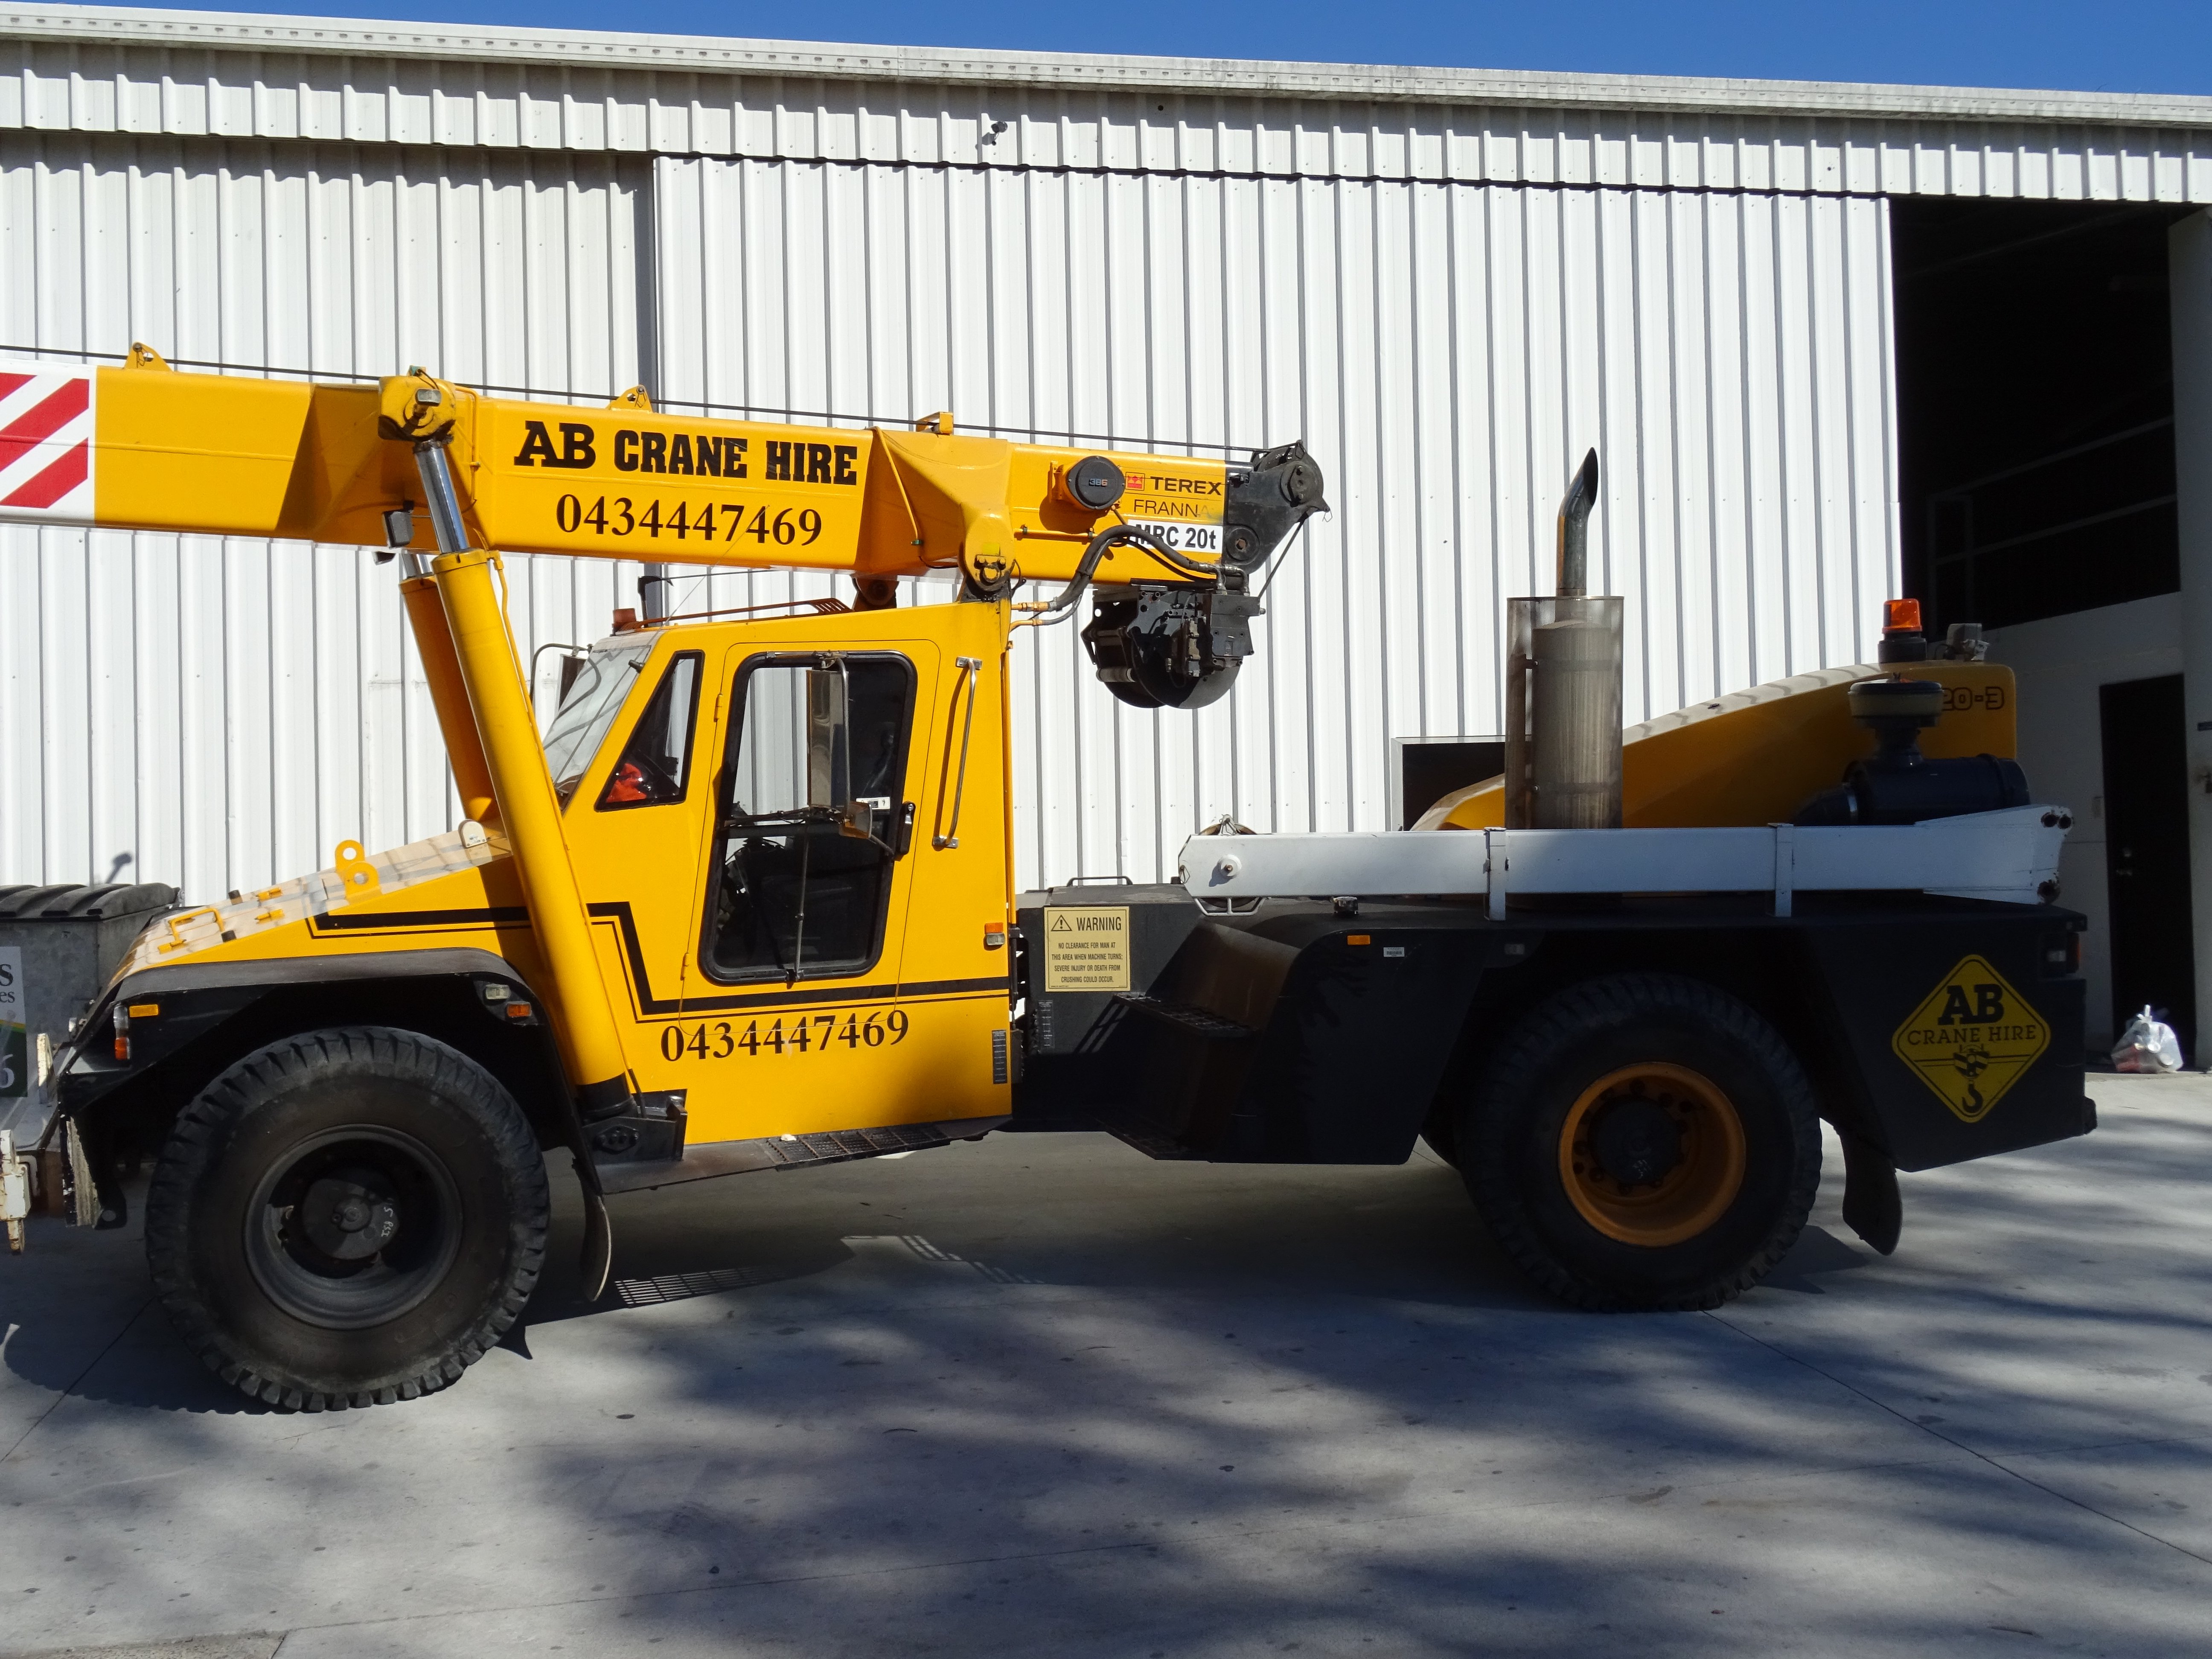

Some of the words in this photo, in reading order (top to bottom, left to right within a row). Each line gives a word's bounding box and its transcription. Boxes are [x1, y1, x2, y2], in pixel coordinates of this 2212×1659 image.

[514, 420, 596, 469] AB
[614, 429, 748, 479] CRANE
[765, 440, 857, 486] HIRE
[1150, 476, 1222, 496] TEREX
[556, 493, 822, 546] 0434447469
[1185, 527, 1217, 550] 20t
[1076, 917, 1122, 931] WARNING
[1937, 983, 2005, 1025] AB
[660, 1010, 909, 1062] 0434447469
[1907, 1027, 1980, 1046] CRANE
[1988, 1025, 2036, 1042] HIRE
